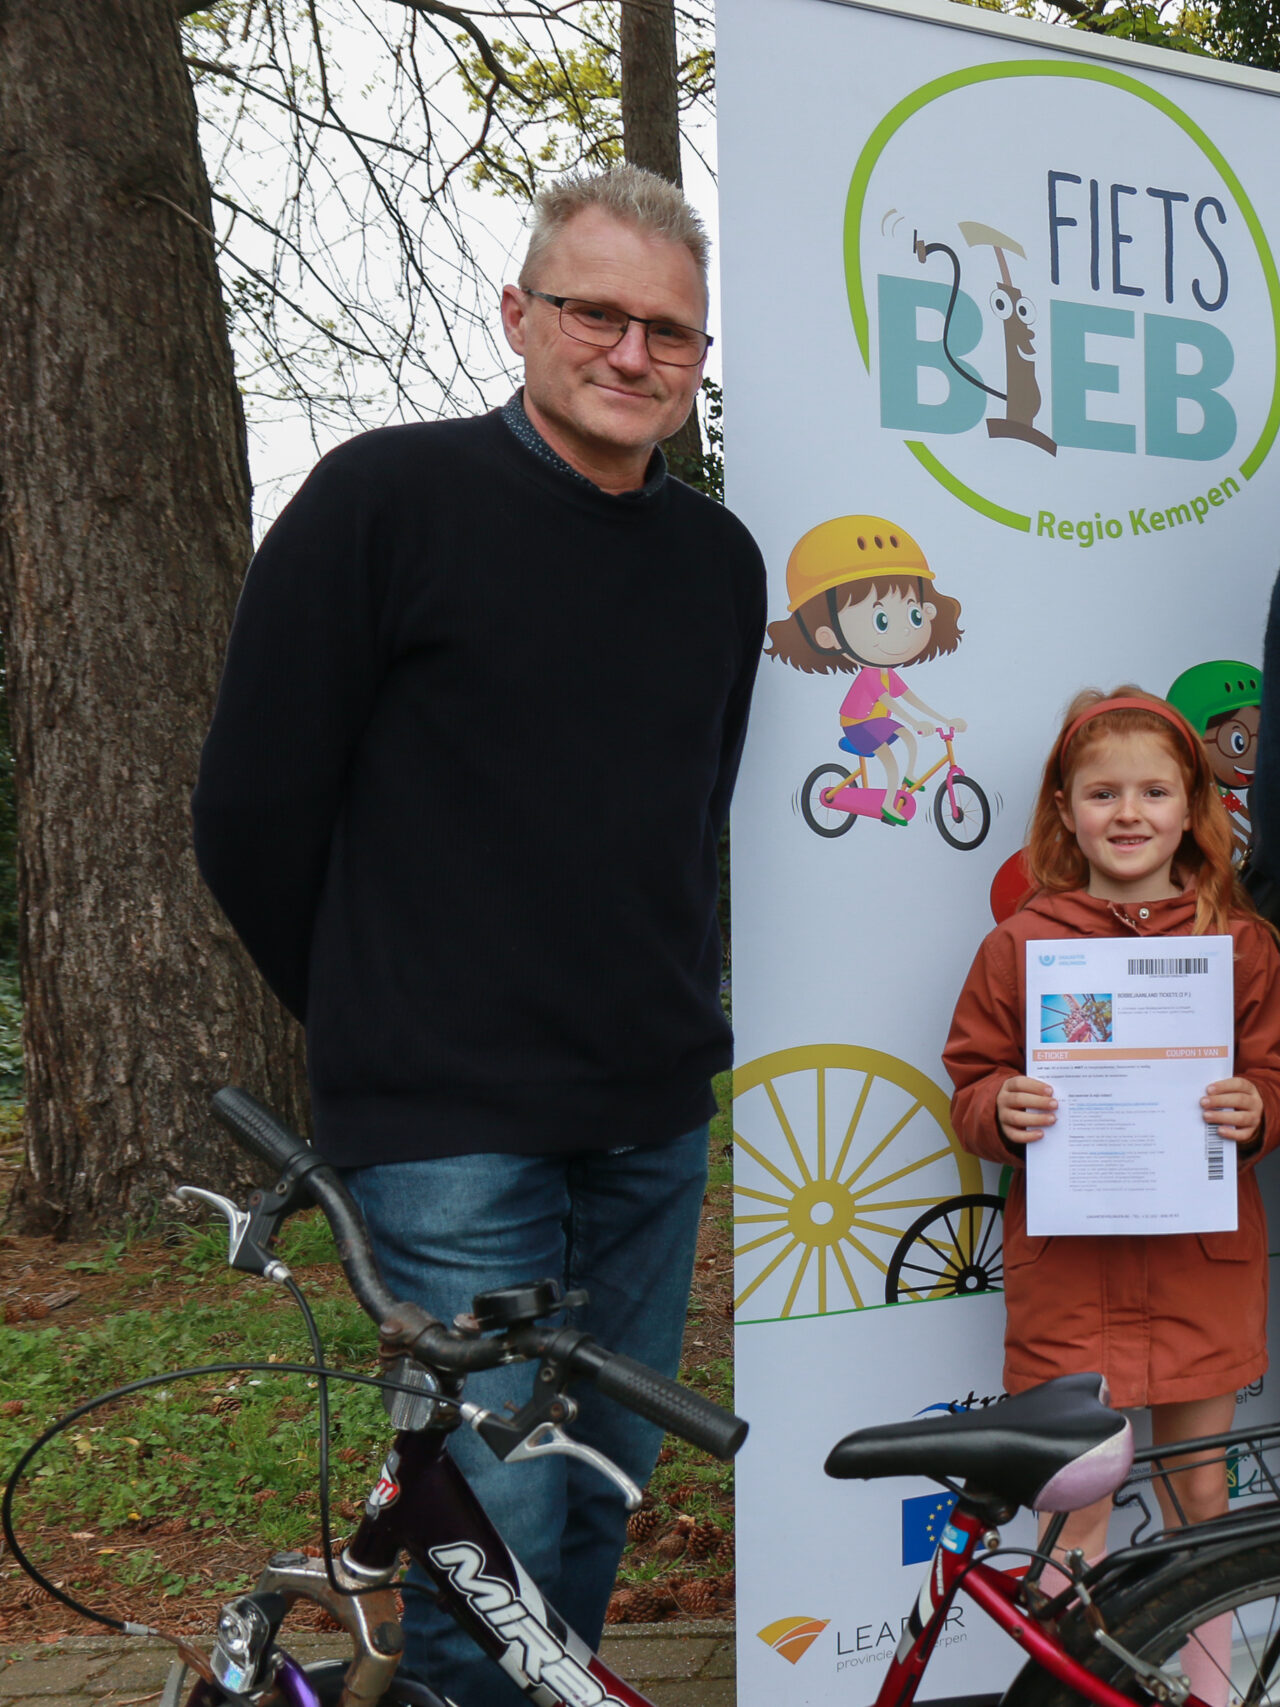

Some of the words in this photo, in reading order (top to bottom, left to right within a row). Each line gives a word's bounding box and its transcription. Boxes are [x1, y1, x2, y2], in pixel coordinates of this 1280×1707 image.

[1047, 169, 1229, 312] FIETS
[877, 273, 1238, 462] BIEB
[1036, 510, 1123, 548] Regio
[1129, 475, 1241, 536] Kempen
[837, 1605, 965, 1656] LEAR
